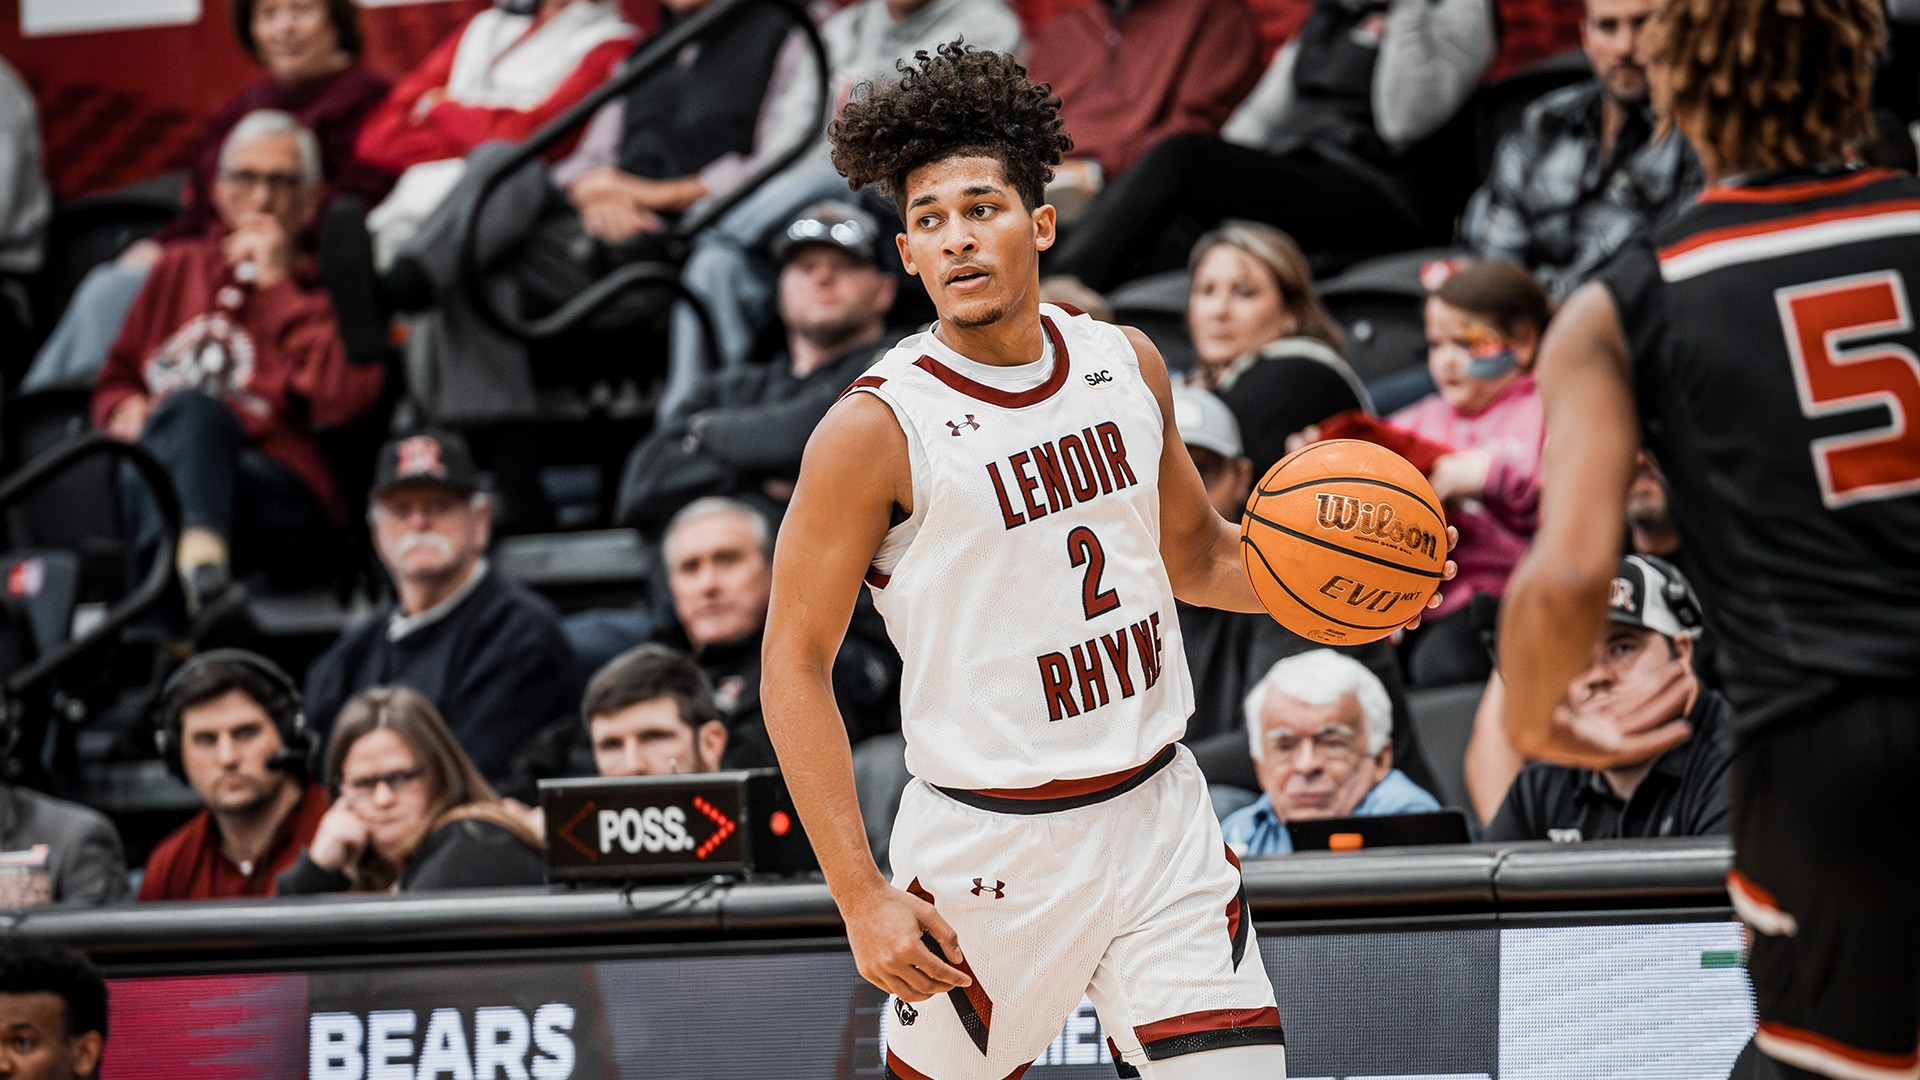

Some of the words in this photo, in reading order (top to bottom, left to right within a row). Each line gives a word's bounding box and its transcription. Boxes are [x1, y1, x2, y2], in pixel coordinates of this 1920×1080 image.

[1084, 369, 1113, 386] SAC
[1774, 268, 1920, 511] 5
[985, 420, 1138, 531] LENOIR
[1316, 493, 1436, 560] Wilson
[1066, 525, 1121, 621] 2
[1400, 590, 1422, 601] NXT
[1036, 611, 1163, 723] RHYNE
[598, 806, 695, 854] POSS.
[308, 1002, 576, 1080] BEARS
